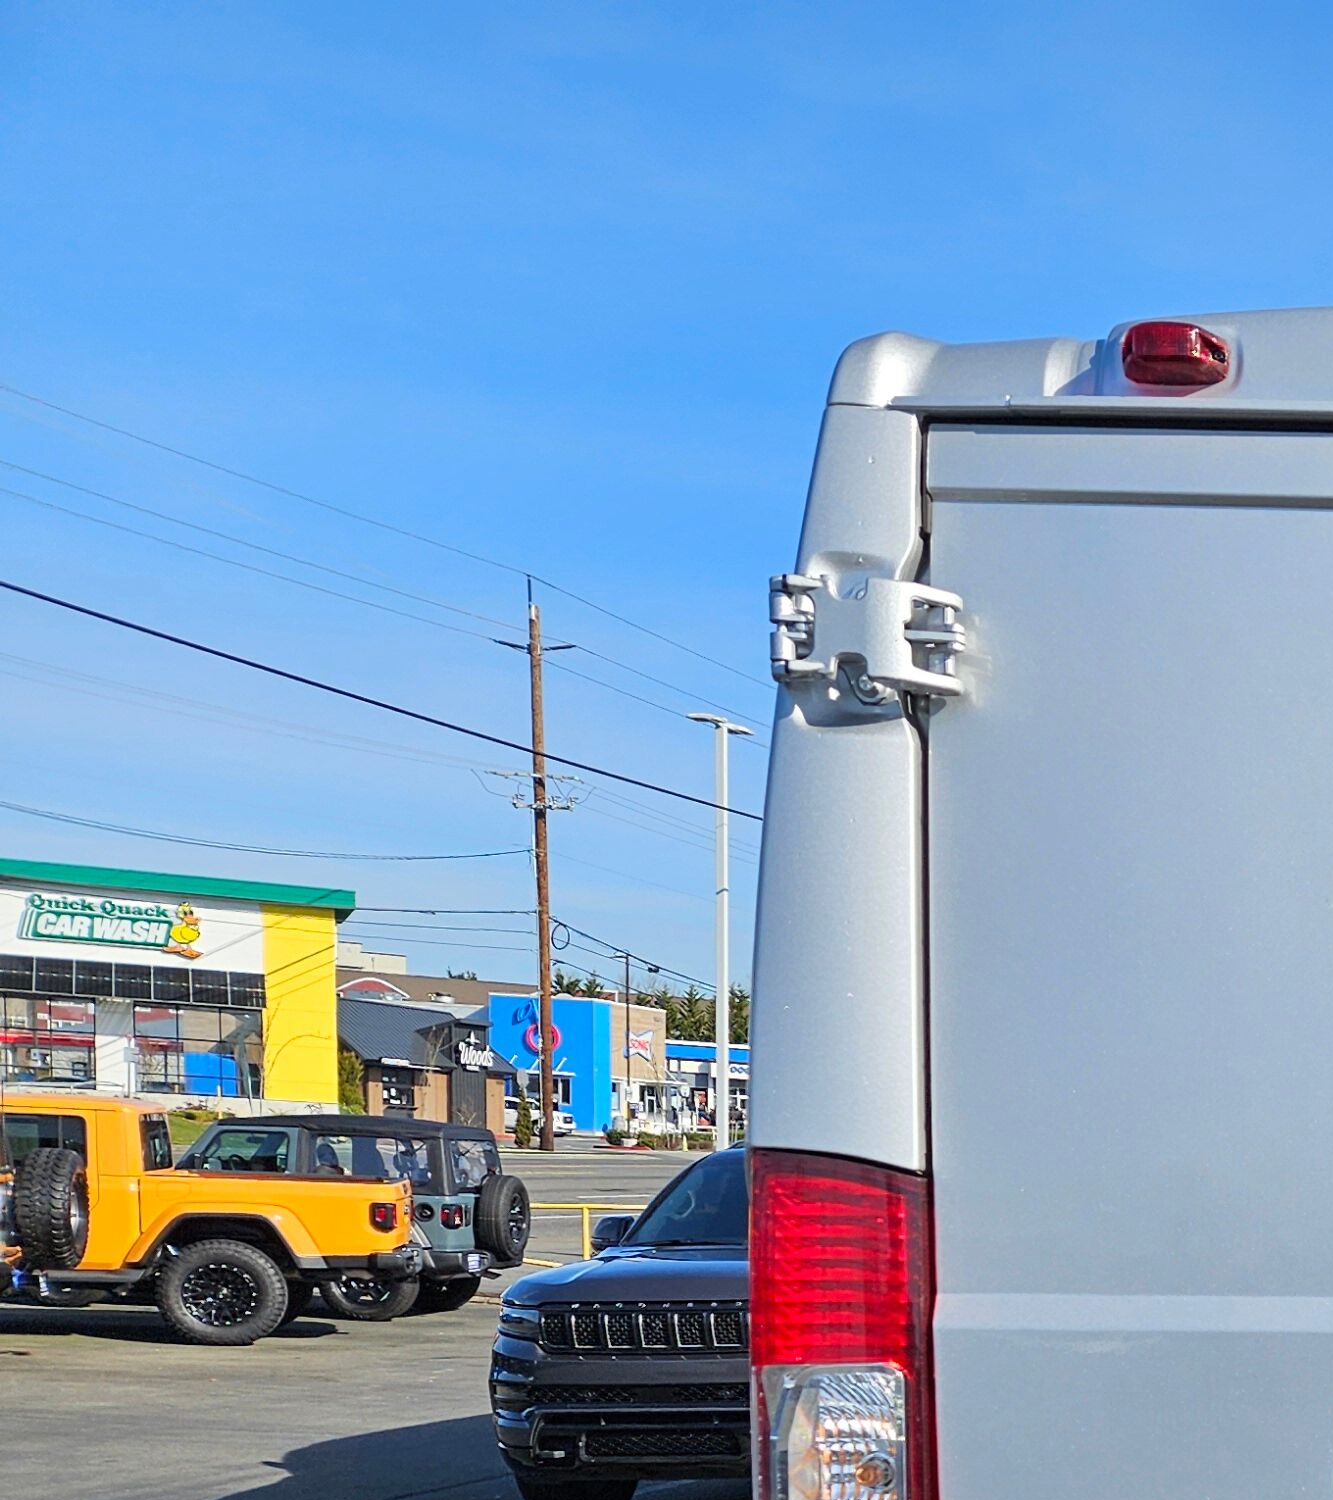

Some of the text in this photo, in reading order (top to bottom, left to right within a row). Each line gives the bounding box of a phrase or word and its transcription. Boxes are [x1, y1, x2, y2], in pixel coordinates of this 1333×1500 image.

[28, 893, 169, 918] Quick Quack
[37, 912, 169, 943] CAR WASH
[459, 1041, 494, 1067] Woods
